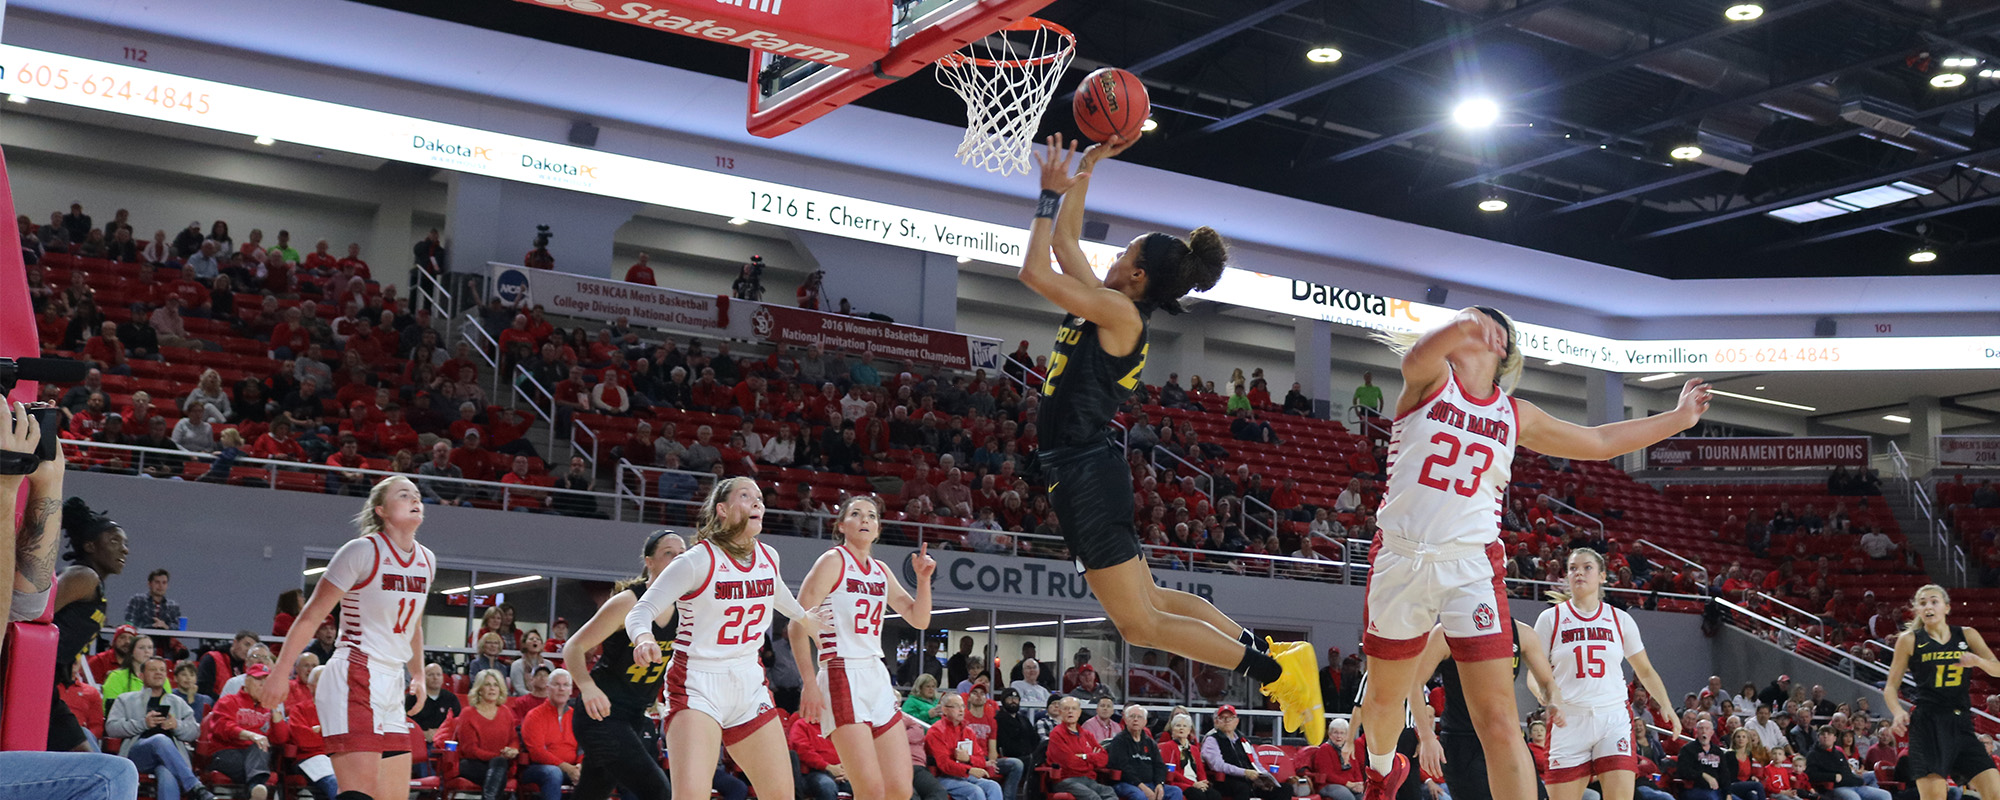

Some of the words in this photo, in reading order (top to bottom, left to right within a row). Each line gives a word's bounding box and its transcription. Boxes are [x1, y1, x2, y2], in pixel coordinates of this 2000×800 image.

[607, 2, 737, 39] State
[728, 29, 850, 63] Farm
[123, 47, 147, 63] 112
[17, 63, 210, 114] 605-624-4845
[715, 156, 735, 169] 113
[750, 191, 798, 217] 1216
[806, 202, 821, 222] E.
[829, 206, 892, 239] Cherry
[900, 218, 927, 243] St.,
[934, 224, 1020, 257] Vermillion
[553, 294, 590, 312] College
[592, 300, 631, 317] Division
[633, 304, 674, 323] National
[675, 312, 727, 330] Champio
[576, 282, 601, 294] 1958
[602, 285, 627, 300] NCAA
[630, 289, 656, 304] Men's
[659, 291, 708, 312] Basketball
[821, 318, 843, 332] 2016
[844, 322, 883, 338] Women's
[885, 328, 929, 345] Basketball
[1875, 324, 1891, 333] 101
[782, 327, 820, 343] National
[822, 332, 865, 350] Invitation
[867, 341, 919, 359] Tournament
[920, 348, 966, 366] Champions
[1543, 336, 1552, 352] E.
[1557, 338, 1597, 364] Cherry
[1601, 346, 1619, 366] St.,
[1625, 347, 1708, 364] Vermillion
[1715, 347, 1840, 363] 605-624-4845
[1418, 431, 1494, 498] 23
[1651, 450, 1692, 460] SUMMIT
[1697, 445, 1784, 461] TOURNAMENT
[1786, 444, 1863, 460] CHAMPIONS
[1975, 452, 1997, 462] 2014
[714, 580, 744, 600] SOUTH
[745, 578, 775, 599] DAKOTA
[393, 597, 416, 634] 11
[716, 603, 766, 645] 22
[854, 598, 883, 636] 24
[1561, 627, 1586, 644] SOUTH
[1587, 627, 1614, 643] DAKOTA
[1573, 645, 1607, 679] 15
[1921, 651, 1965, 663] MIZZO
[1935, 664, 1964, 688] 13
